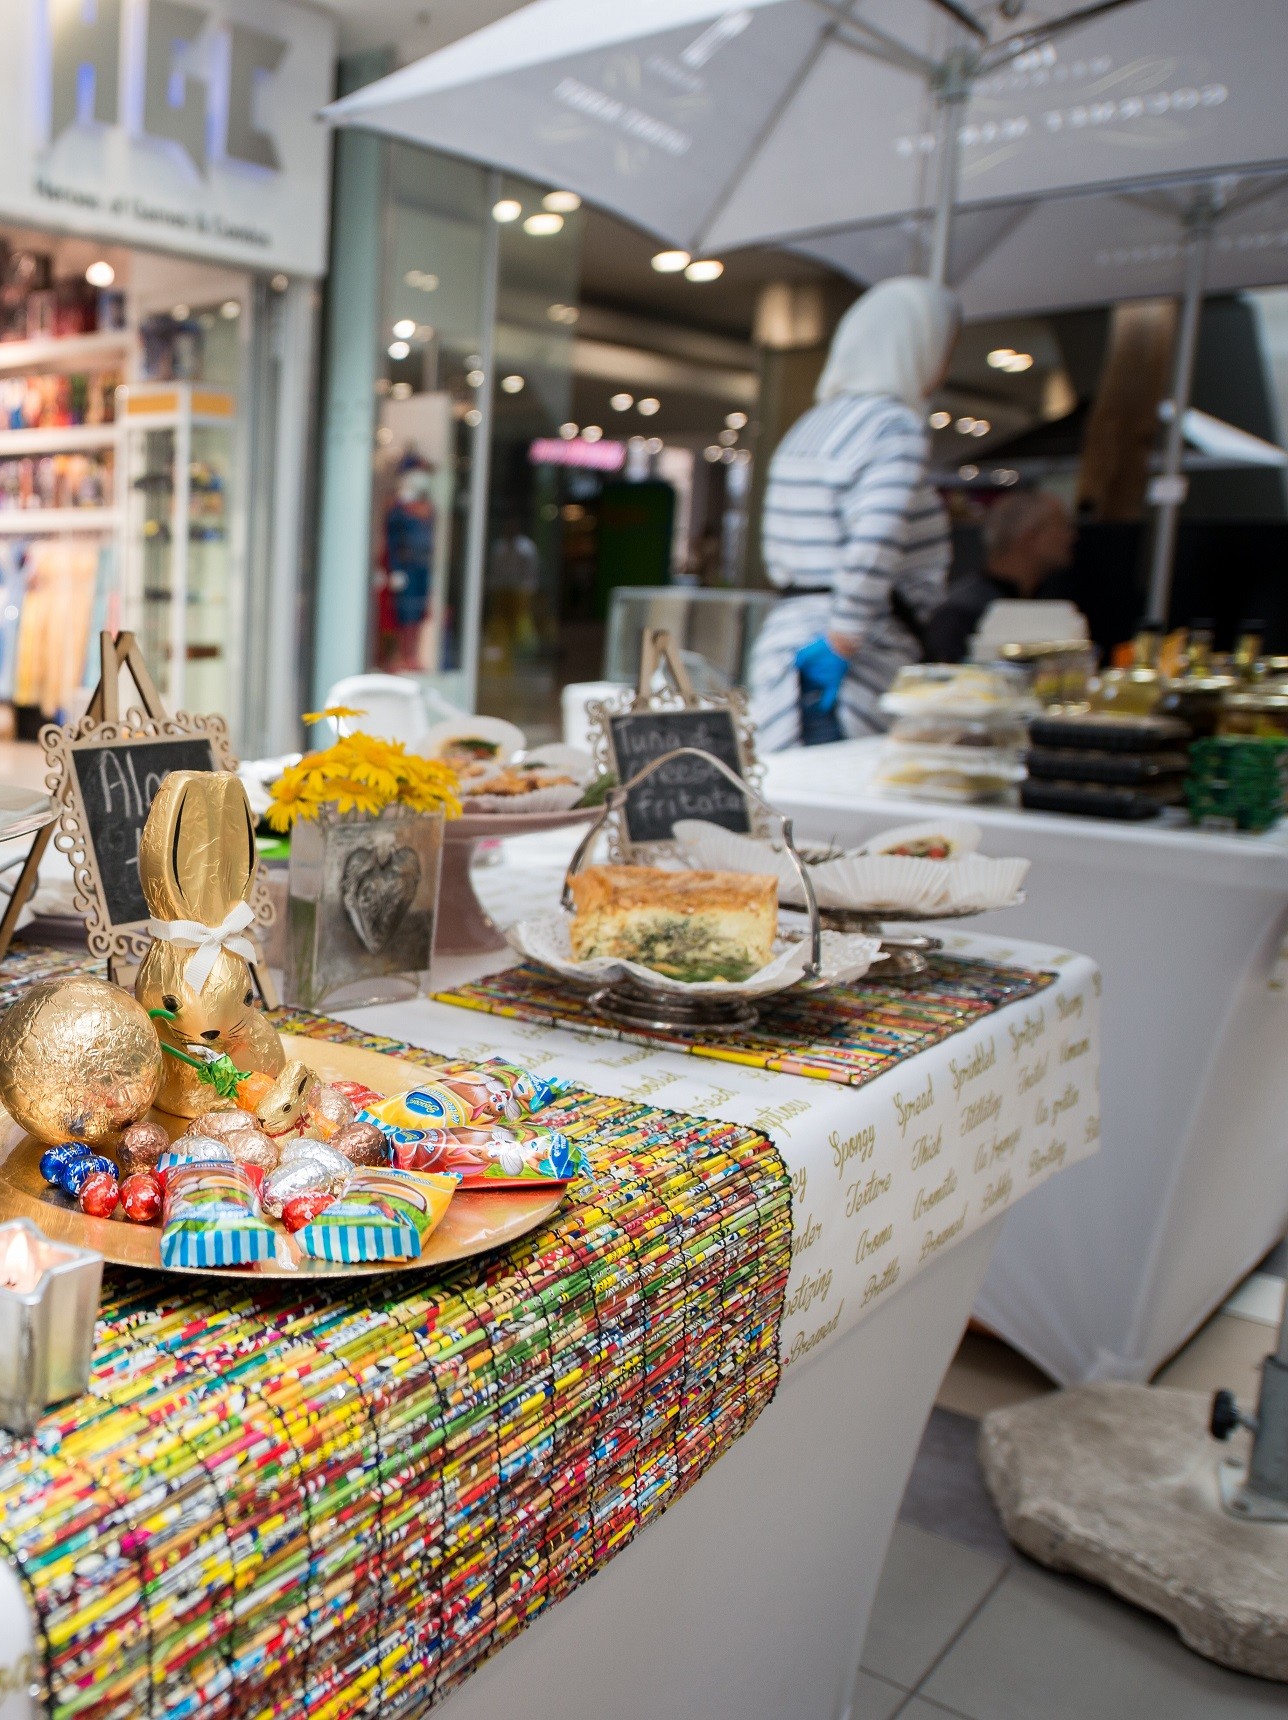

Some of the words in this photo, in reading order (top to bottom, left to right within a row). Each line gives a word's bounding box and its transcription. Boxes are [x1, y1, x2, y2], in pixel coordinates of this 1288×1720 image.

[892, 1072, 934, 1139] Spread
[828, 1124, 876, 1181] Spongy
[845, 1169, 892, 1218] Texture
[791, 1212, 823, 1257] nder
